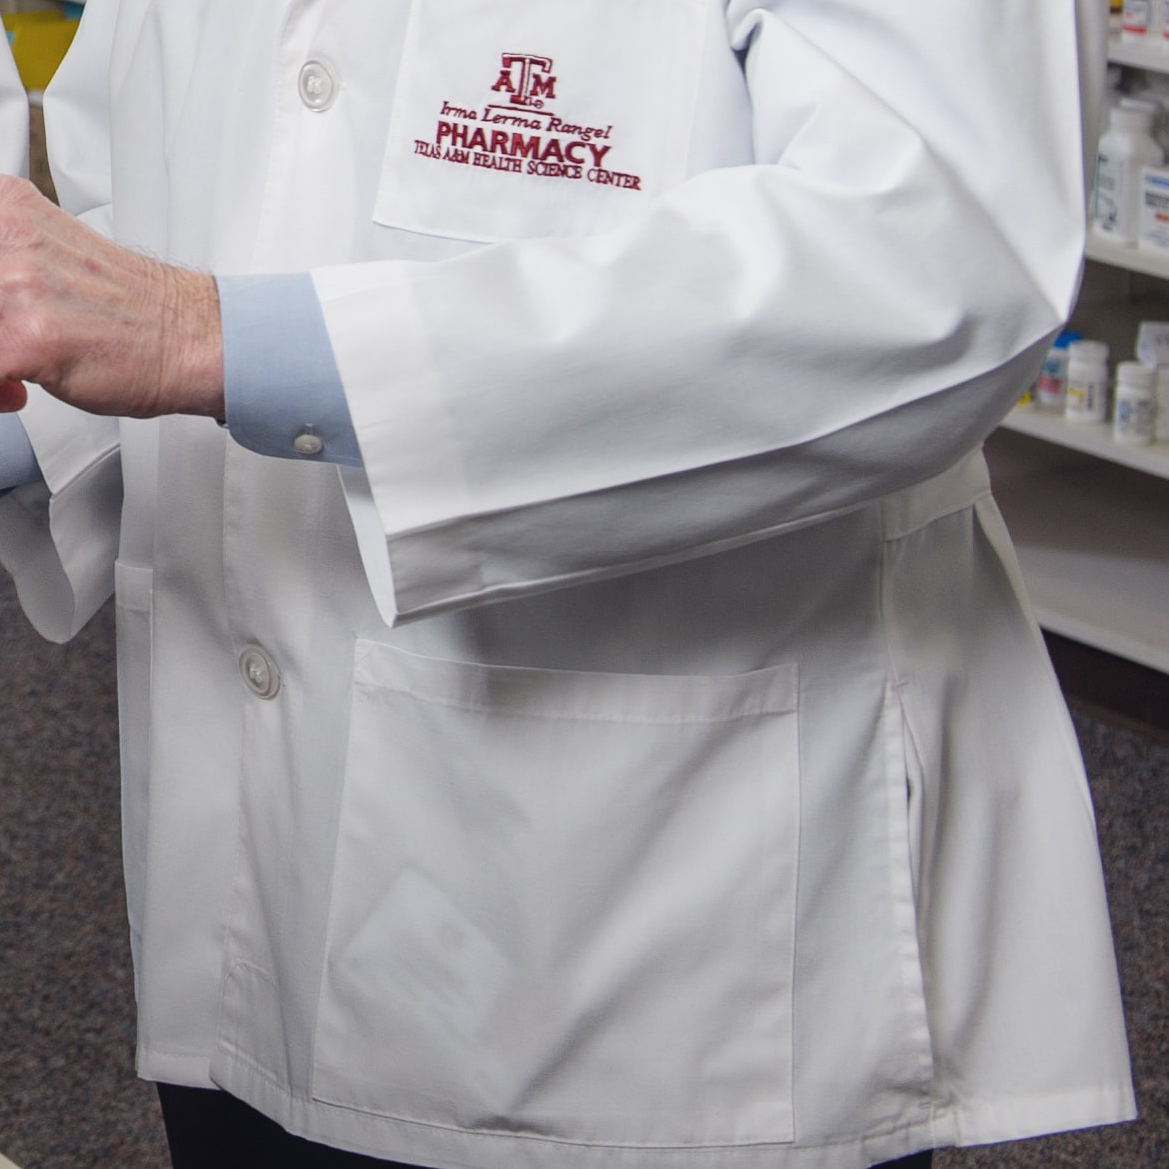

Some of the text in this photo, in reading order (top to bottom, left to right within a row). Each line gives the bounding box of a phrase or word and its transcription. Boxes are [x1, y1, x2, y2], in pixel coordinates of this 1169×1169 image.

[435, 120, 612, 168] PHARMACY
[440, 101, 613, 141] Irma Lerma Rangel
[414, 139, 642, 191] TEXAS A&M HEALTH SCIENCE CENTER
